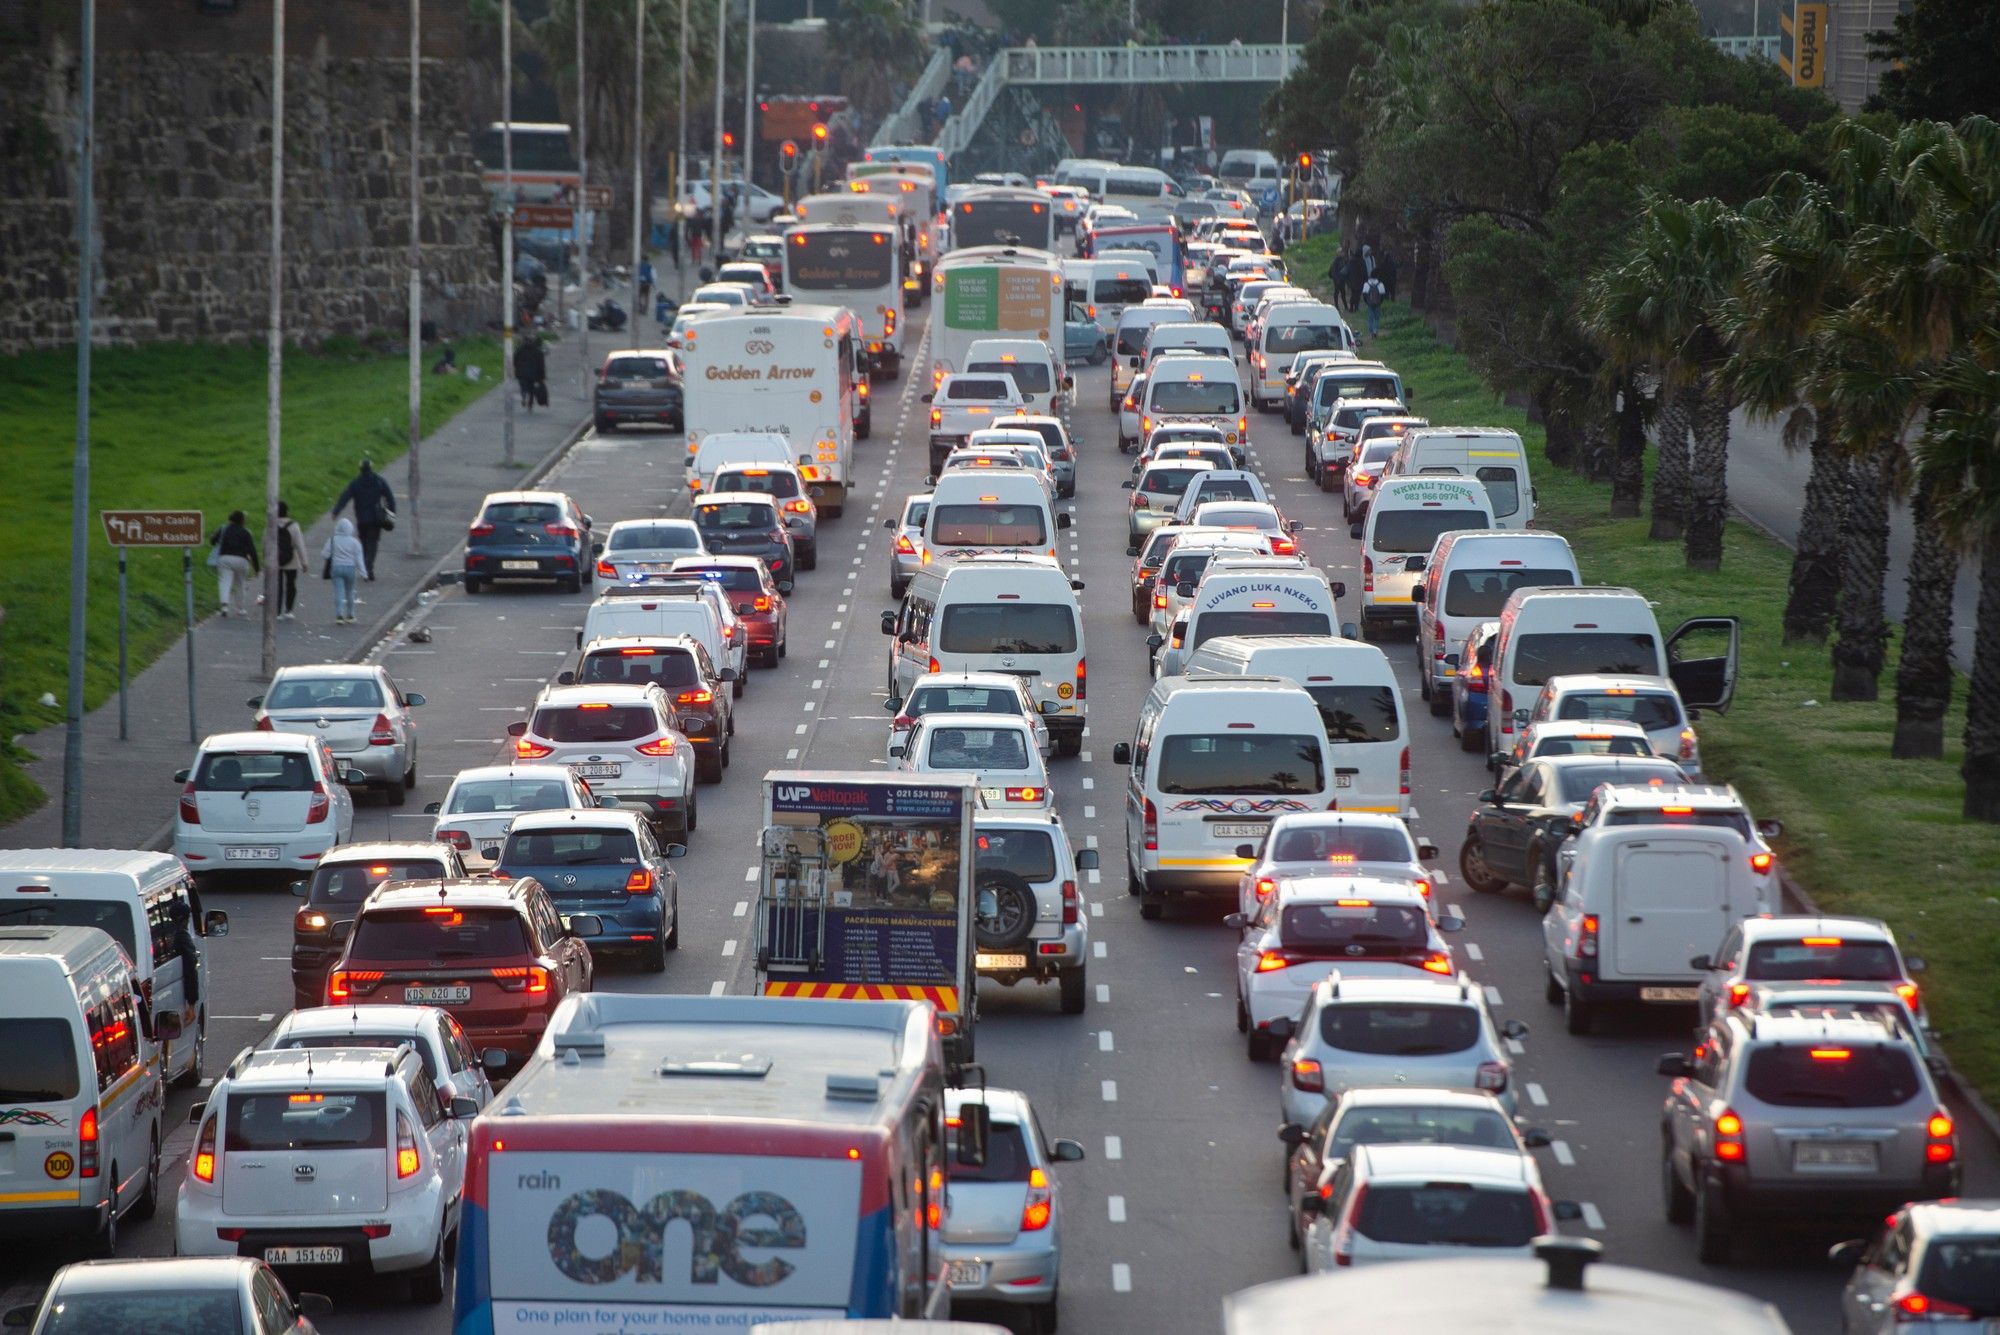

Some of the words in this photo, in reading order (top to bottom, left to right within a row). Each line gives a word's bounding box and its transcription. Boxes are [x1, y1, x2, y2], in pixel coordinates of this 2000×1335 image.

[1801, 11, 1819, 80] metro
[705, 364, 760, 380] Golden
[767, 364, 816, 380] Arrow
[1392, 482, 1435, 496] NKWALI
[1437, 482, 1473, 497] TOURS
[1422, 492, 1438, 500] 966
[1439, 493, 1459, 501] 0974
[144, 515, 161, 525] The
[165, 515, 195, 525] Castle
[144, 532, 160, 541] Die
[1206, 585, 1248, 609] LUVANO
[1251, 583, 1281, 593] LUKA
[1284, 586, 1318, 610] NXEKO
[777, 786, 811, 801] UVP
[896, 789, 911, 798] 021
[913, 790, 929, 798] 534
[406, 988, 424, 1000] KDS
[431, 987, 449, 999] 620
[456, 987, 468, 998] EC
[50, 1159, 70, 1171] 100
[517, 1170, 561, 1190] rain
[547, 1187, 807, 1288] one
[267, 1250, 287, 1262] CAA
[516, 1308, 550, 1323] One
[553, 1308, 591, 1326] plan
[595, 1308, 617, 1322] for
[621, 1312, 659, 1327] your
[662, 1310, 710, 1325] home
[716, 1310, 748, 1325] and
